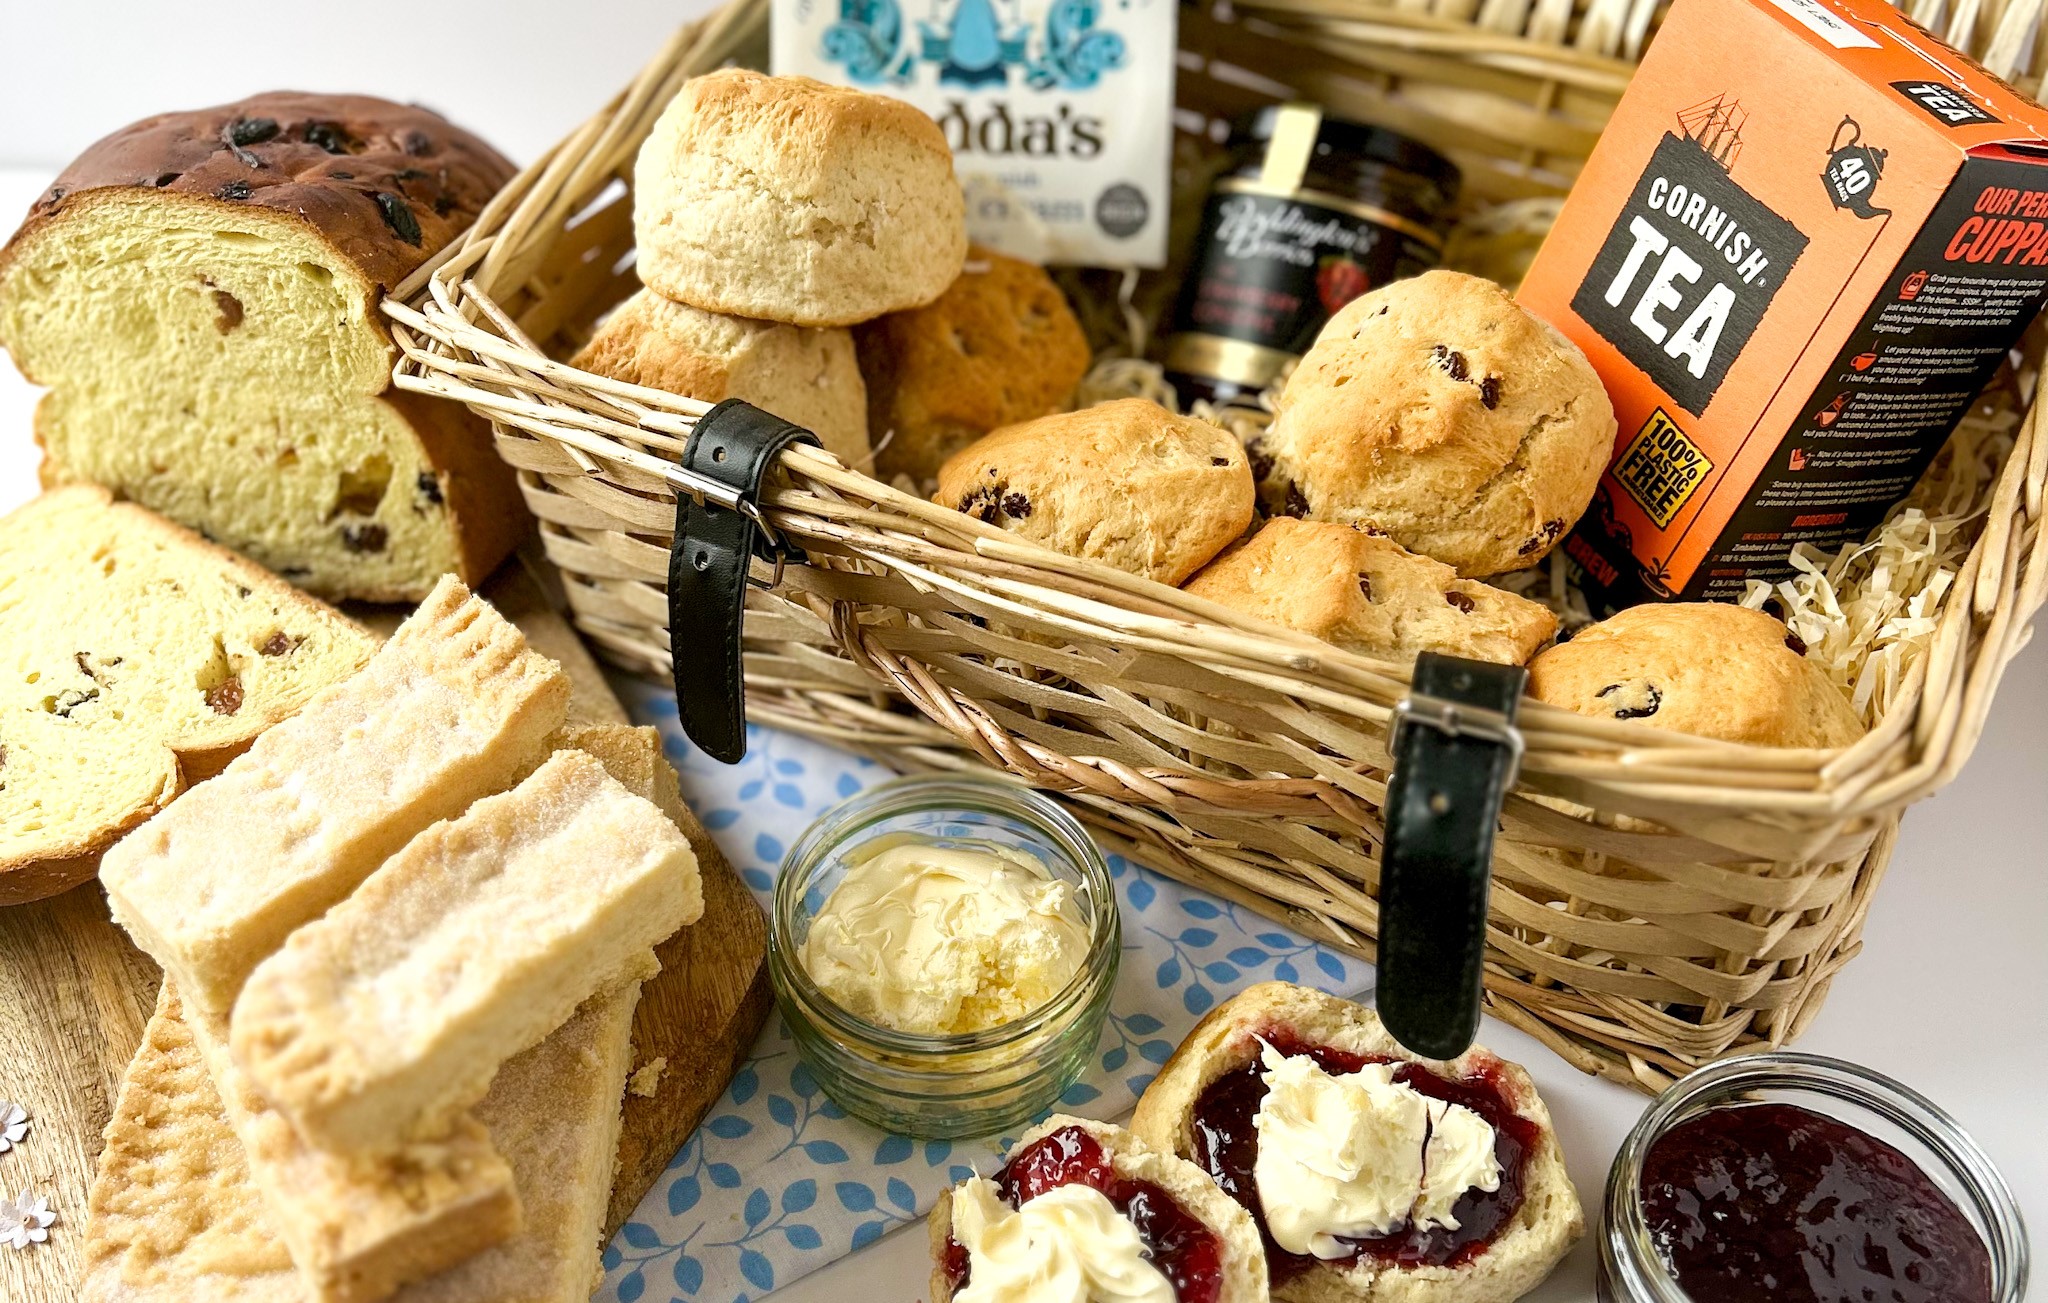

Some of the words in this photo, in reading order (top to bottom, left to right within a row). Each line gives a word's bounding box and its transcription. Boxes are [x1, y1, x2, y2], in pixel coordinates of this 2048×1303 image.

[1908, 84, 1974, 122] TEA
[1931, 84, 1987, 120] CORNISH
[938, 98, 1105, 158] dda's
[1829, 167, 1840, 184] TEA
[1835, 180, 1850, 202] BAGS
[1839, 157, 1871, 195] 40
[1973, 186, 2020, 215] OUR
[2011, 190, 2048, 218] PER
[1923, 285, 1937, 294] bag
[1930, 274, 1947, 282] Grab
[1960, 276, 1987, 285] favourite
[1986, 279, 2000, 287] mug
[1604, 214, 1736, 380] TEA
[1927, 306, 1951, 317] looking
[1872, 323, 1903, 333] blighters
[1879, 313, 1903, 324] freshly
[1902, 315, 1924, 324] boiled
[1939, 318, 1962, 327] straight
[1884, 345, 1897, 353] Let
[1894, 347, 1911, 355] your
[1920, 347, 1932, 356] bag
[1917, 367, 1933, 376] gain
[1856, 392, 1873, 401] Whip
[1882, 393, 1895, 402] bag
[1648, 418, 1702, 481] 100%
[1813, 430, 1834, 438] you'll
[1854, 431, 1872, 439] bring
[1637, 436, 1690, 494] PLASTIC
[1623, 451, 1680, 517] FREE
[1791, 513, 1848, 527] INGREDIENTS
[1567, 533, 1620, 588] BREW
